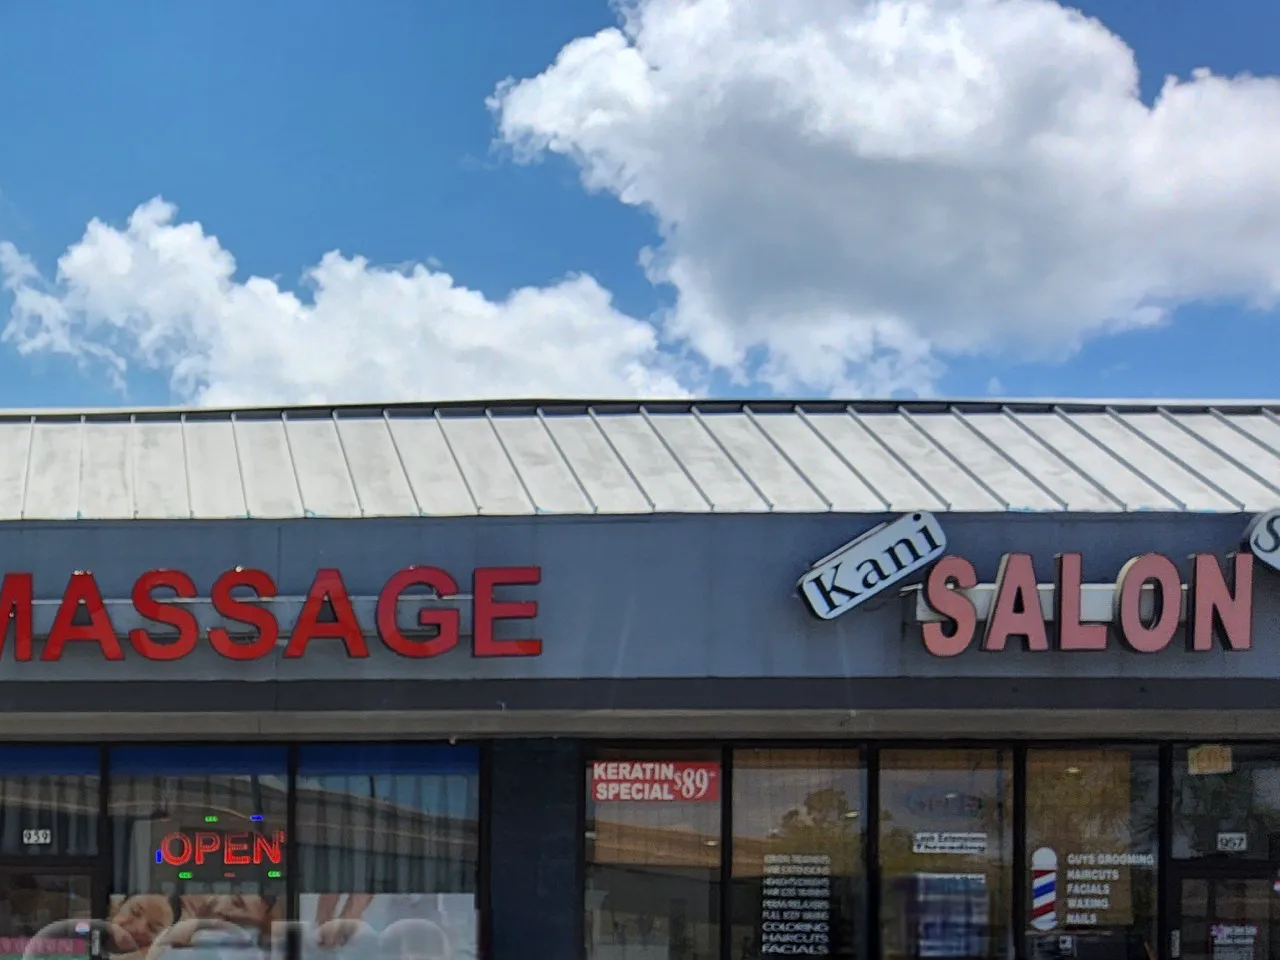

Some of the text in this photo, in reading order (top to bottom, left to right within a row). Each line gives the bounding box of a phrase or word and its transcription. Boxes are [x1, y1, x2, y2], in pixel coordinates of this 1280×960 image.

[808, 513, 943, 616] Kani
[922, 552, 1254, 658] SALON
[593, 762, 674, 781] KERATIN
[595, 783, 674, 801] SPECIAL
[24, 830, 50, 844] 959
[1219, 835, 1245, 850] 957
[159, 831, 283, 867] OPEN
[1066, 869, 1120, 881] HAIRCUTS
[1066, 883, 1111, 895] FACIALS
[1066, 897, 1110, 909] WAXING
[1066, 912, 1098, 925] NAILS
[762, 921, 830, 933] COLORING
[761, 932, 830, 943] HAIRCUTS
[761, 943, 830, 955] FACIALS
